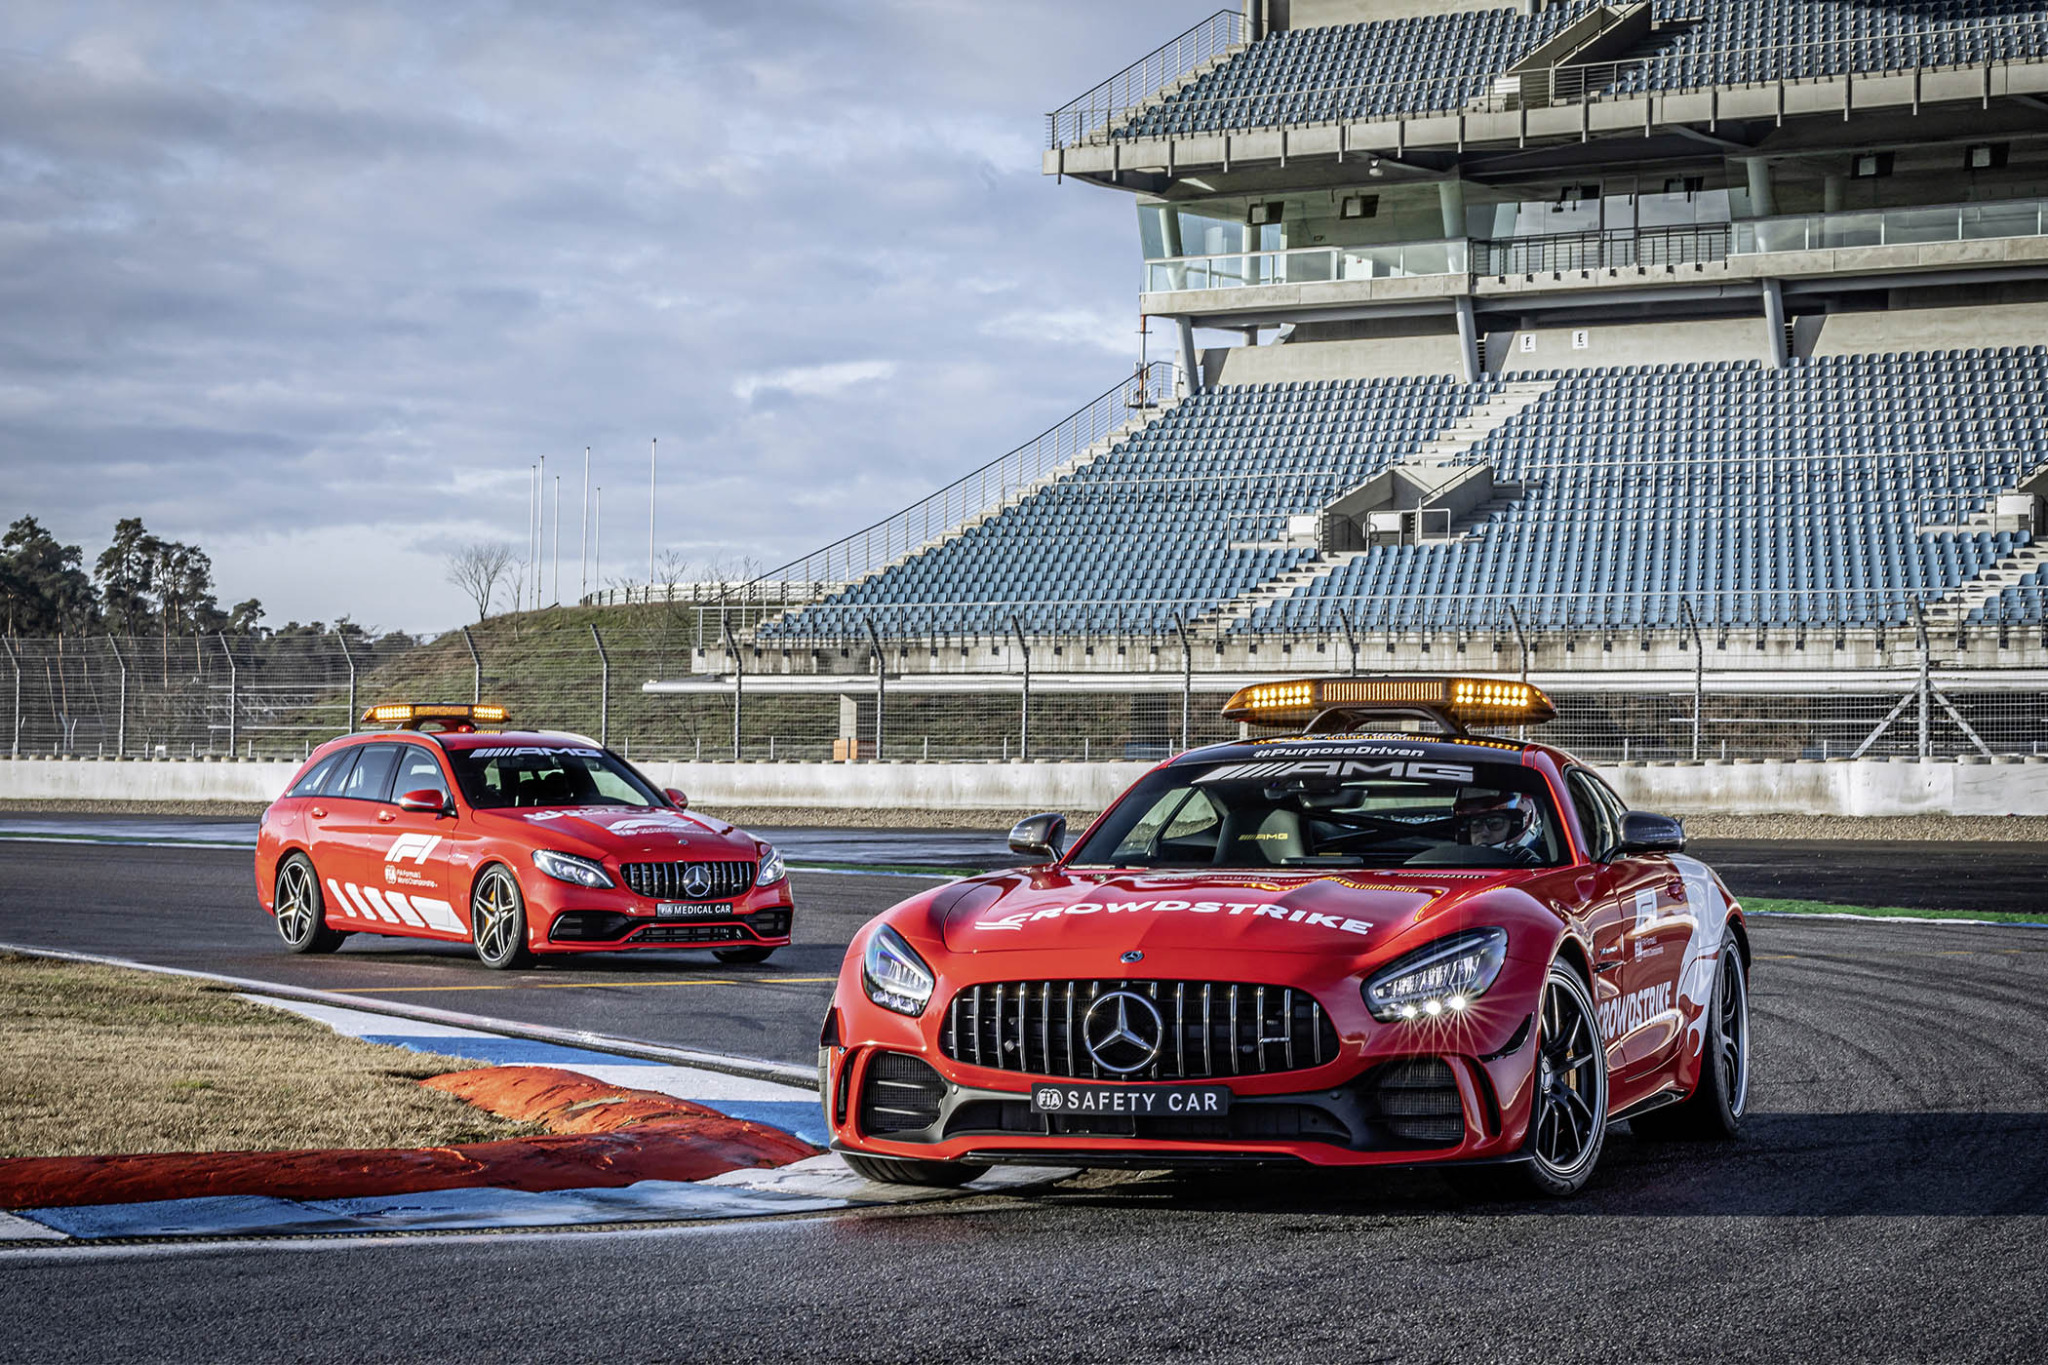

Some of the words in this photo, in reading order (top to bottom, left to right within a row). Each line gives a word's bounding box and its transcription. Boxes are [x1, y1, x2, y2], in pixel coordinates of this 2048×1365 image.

[1253, 745, 1425, 758] #PurposeDriven
[1278, 760, 1474, 782] AMG
[674, 905, 713, 914] MEDICAL
[715, 905, 731, 914] CAR
[975, 900, 1374, 936] CROWDSTRIKE
[1598, 980, 1671, 1041] CROWDSTRIKE
[1037, 1091, 1062, 1107] FIA
[1067, 1090, 1156, 1111] SAFETY
[1168, 1092, 1218, 1111] CAR
